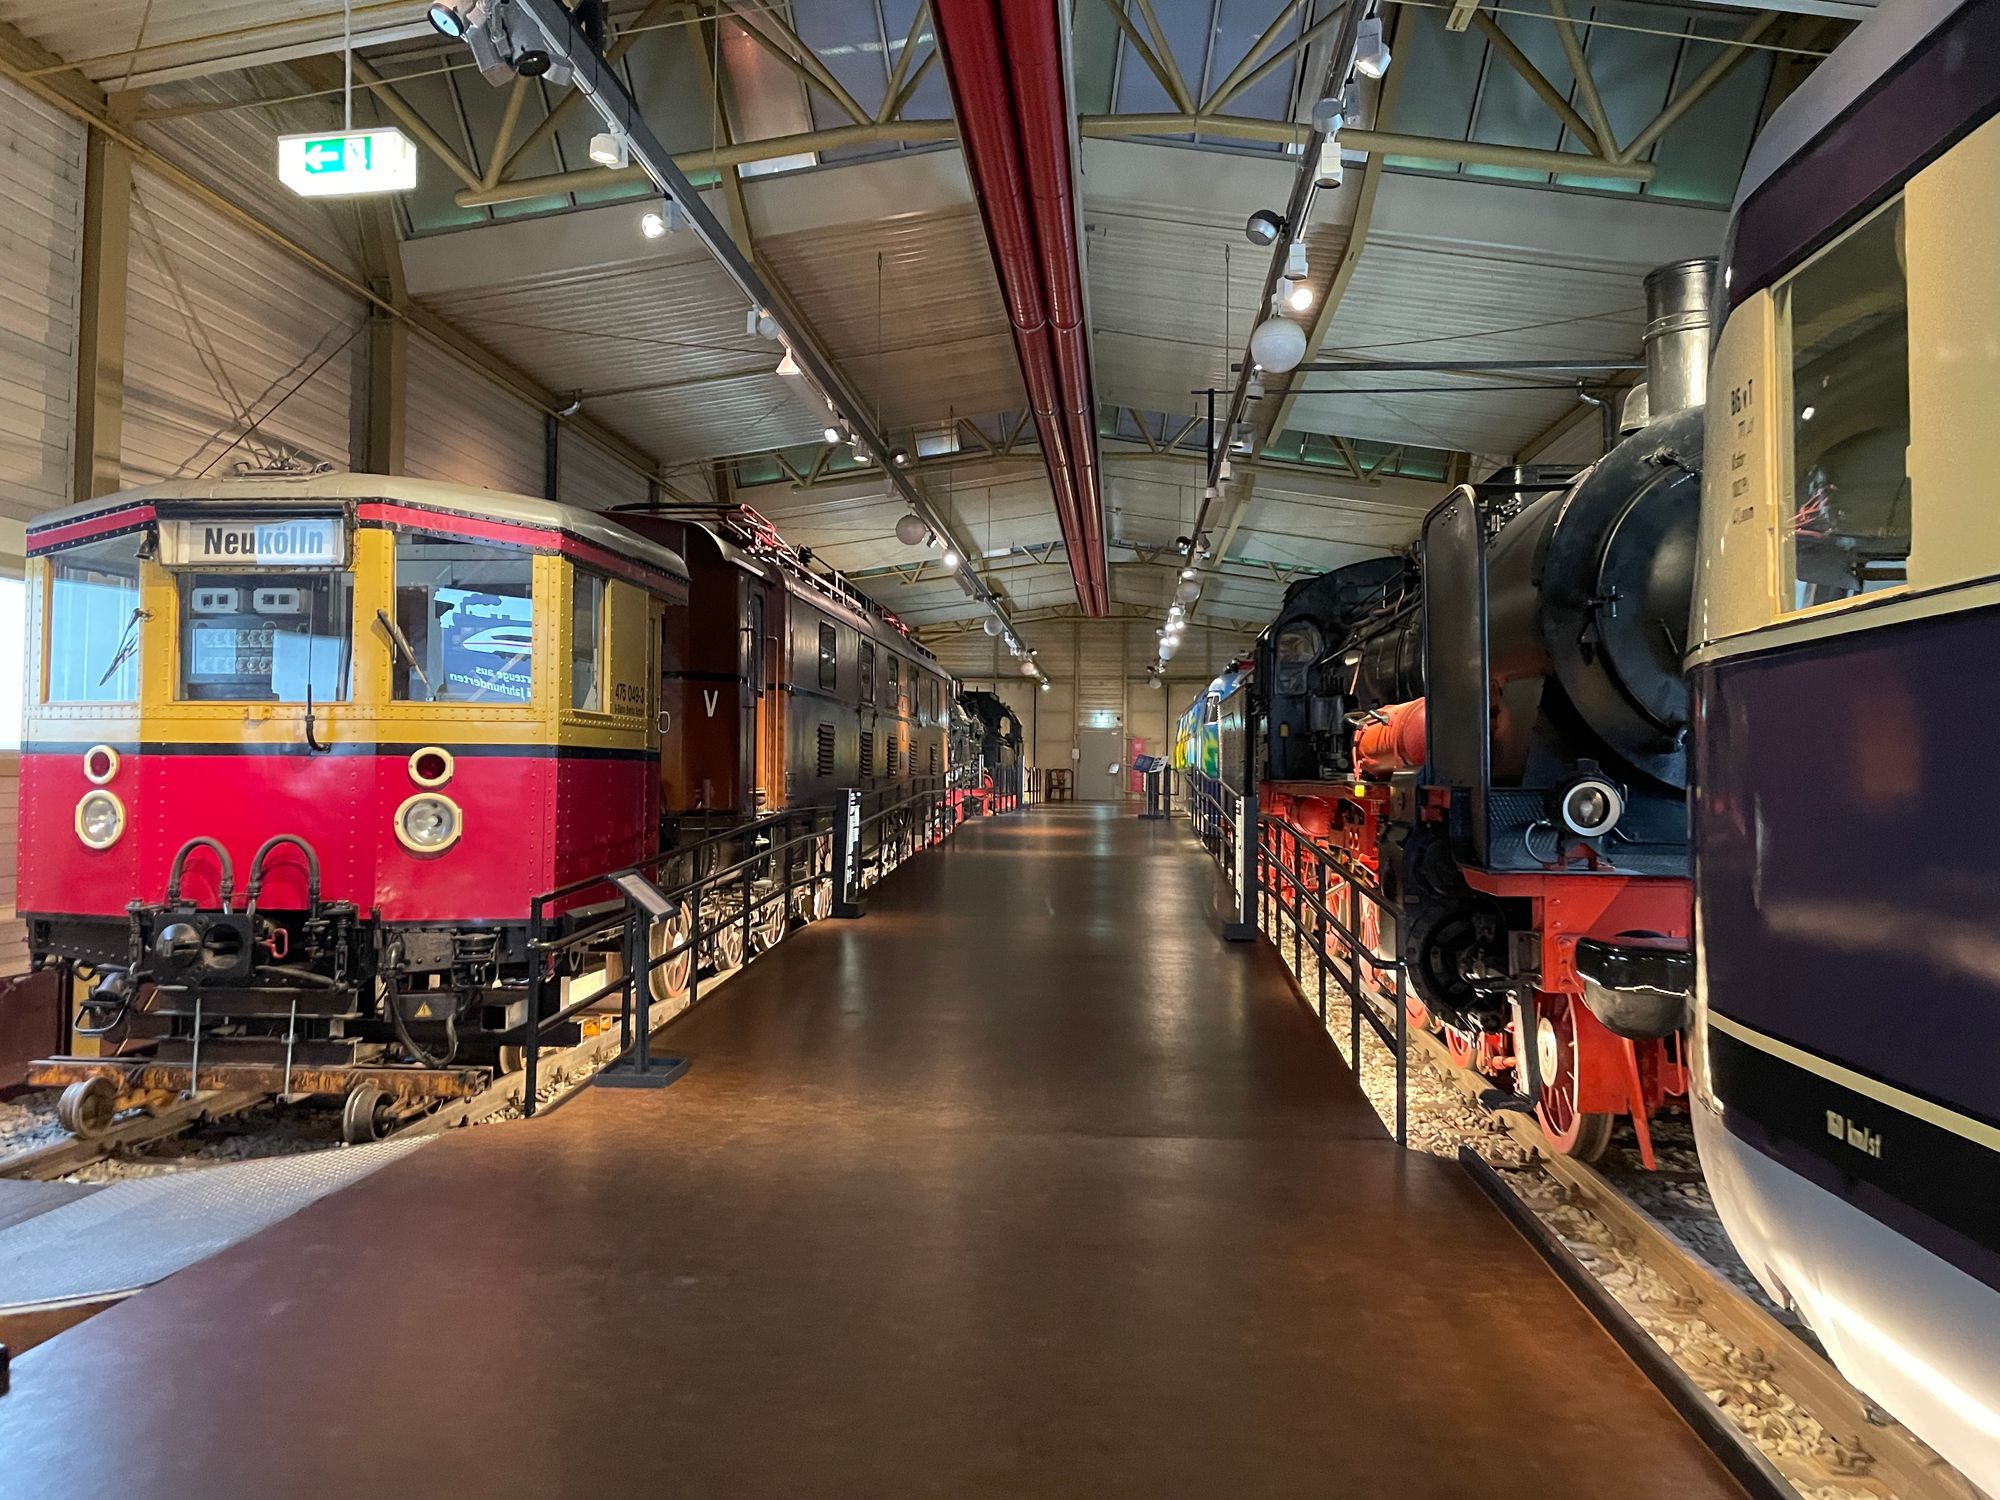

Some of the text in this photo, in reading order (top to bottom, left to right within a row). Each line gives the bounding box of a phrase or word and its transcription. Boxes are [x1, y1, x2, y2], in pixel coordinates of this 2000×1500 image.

[204, 526, 324, 555] Neukölln
[616, 683, 627, 702] 475
[703, 689, 719, 717] V
